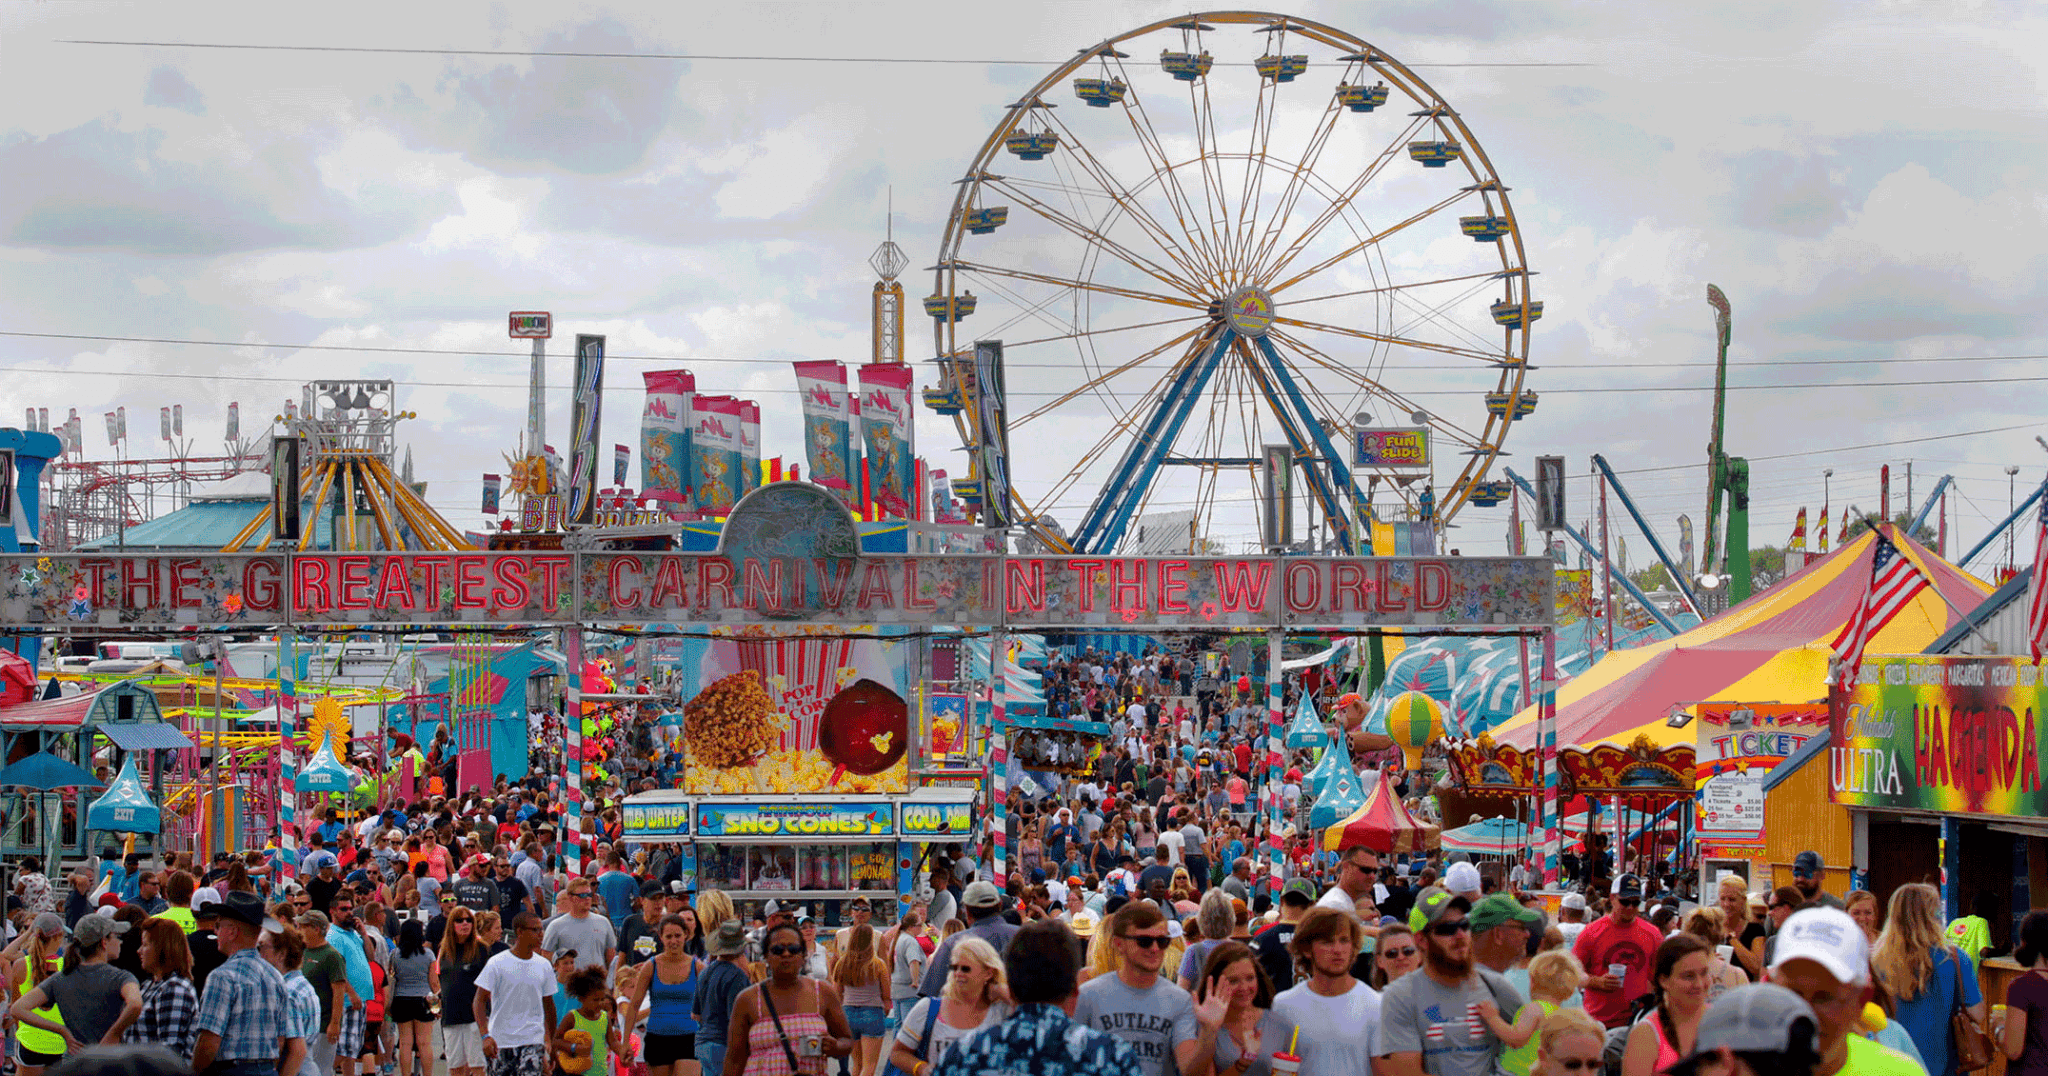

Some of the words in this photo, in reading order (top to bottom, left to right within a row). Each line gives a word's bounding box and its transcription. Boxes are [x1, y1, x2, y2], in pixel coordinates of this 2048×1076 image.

[1385, 435, 1416, 447] FUN
[1381, 447, 1420, 459] SLIDE
[79, 557, 202, 610] THE
[242, 556, 570, 612] GREATEST
[607, 554, 937, 611] CARNIVAL
[981, 559, 1046, 613] IN
[1068, 558, 1190, 614] THE
[1214, 560, 1451, 613] WORLD
[1948, 664, 1985, 686] MARGARITAS
[1991, 666, 2017, 686] MEXICAN
[783, 685, 814, 703] POP
[790, 698, 830, 720] COR
[1711, 731, 1812, 760] TICKET
[1914, 703, 2042, 793] HACIENDA
[1831, 747, 1903, 794] ULTRA
[114, 807, 135, 821] EXIT
[648, 806, 686, 829] WATER
[758, 806, 833, 818] RAINBOW
[905, 805, 942, 832] COLD
[725, 812, 780, 835] SNO
[784, 812, 868, 835] CONES
[1100, 1012, 1174, 1036] BUTLER
[1131, 1041, 1165, 1058] ARS
